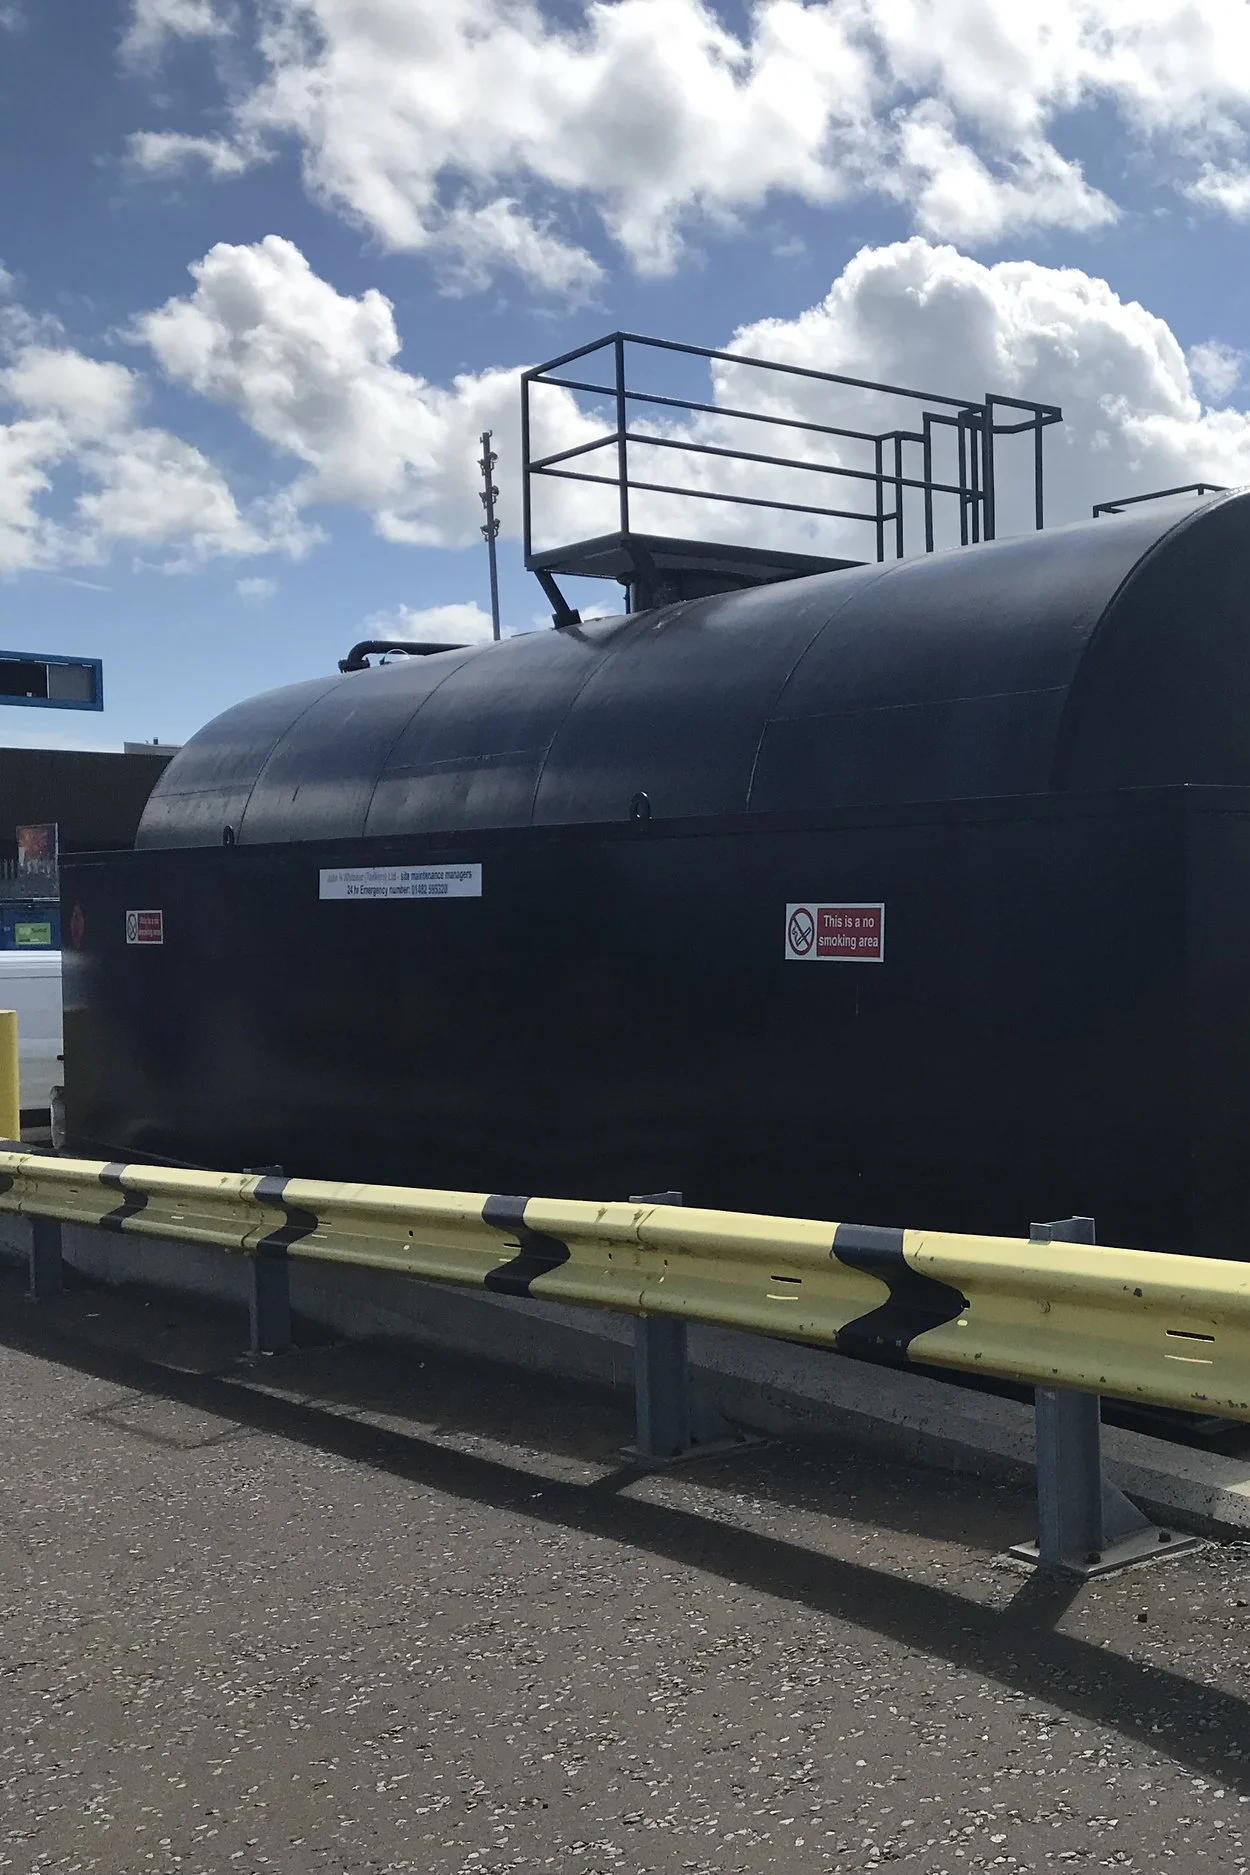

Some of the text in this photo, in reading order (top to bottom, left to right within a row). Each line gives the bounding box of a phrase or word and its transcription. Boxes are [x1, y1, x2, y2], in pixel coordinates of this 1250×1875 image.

[445, 869, 473, 883] managers
[360, 884, 388, 897] Emergency
[823, 915, 875, 928] This is a no
[818, 934, 879, 950] smoking area
